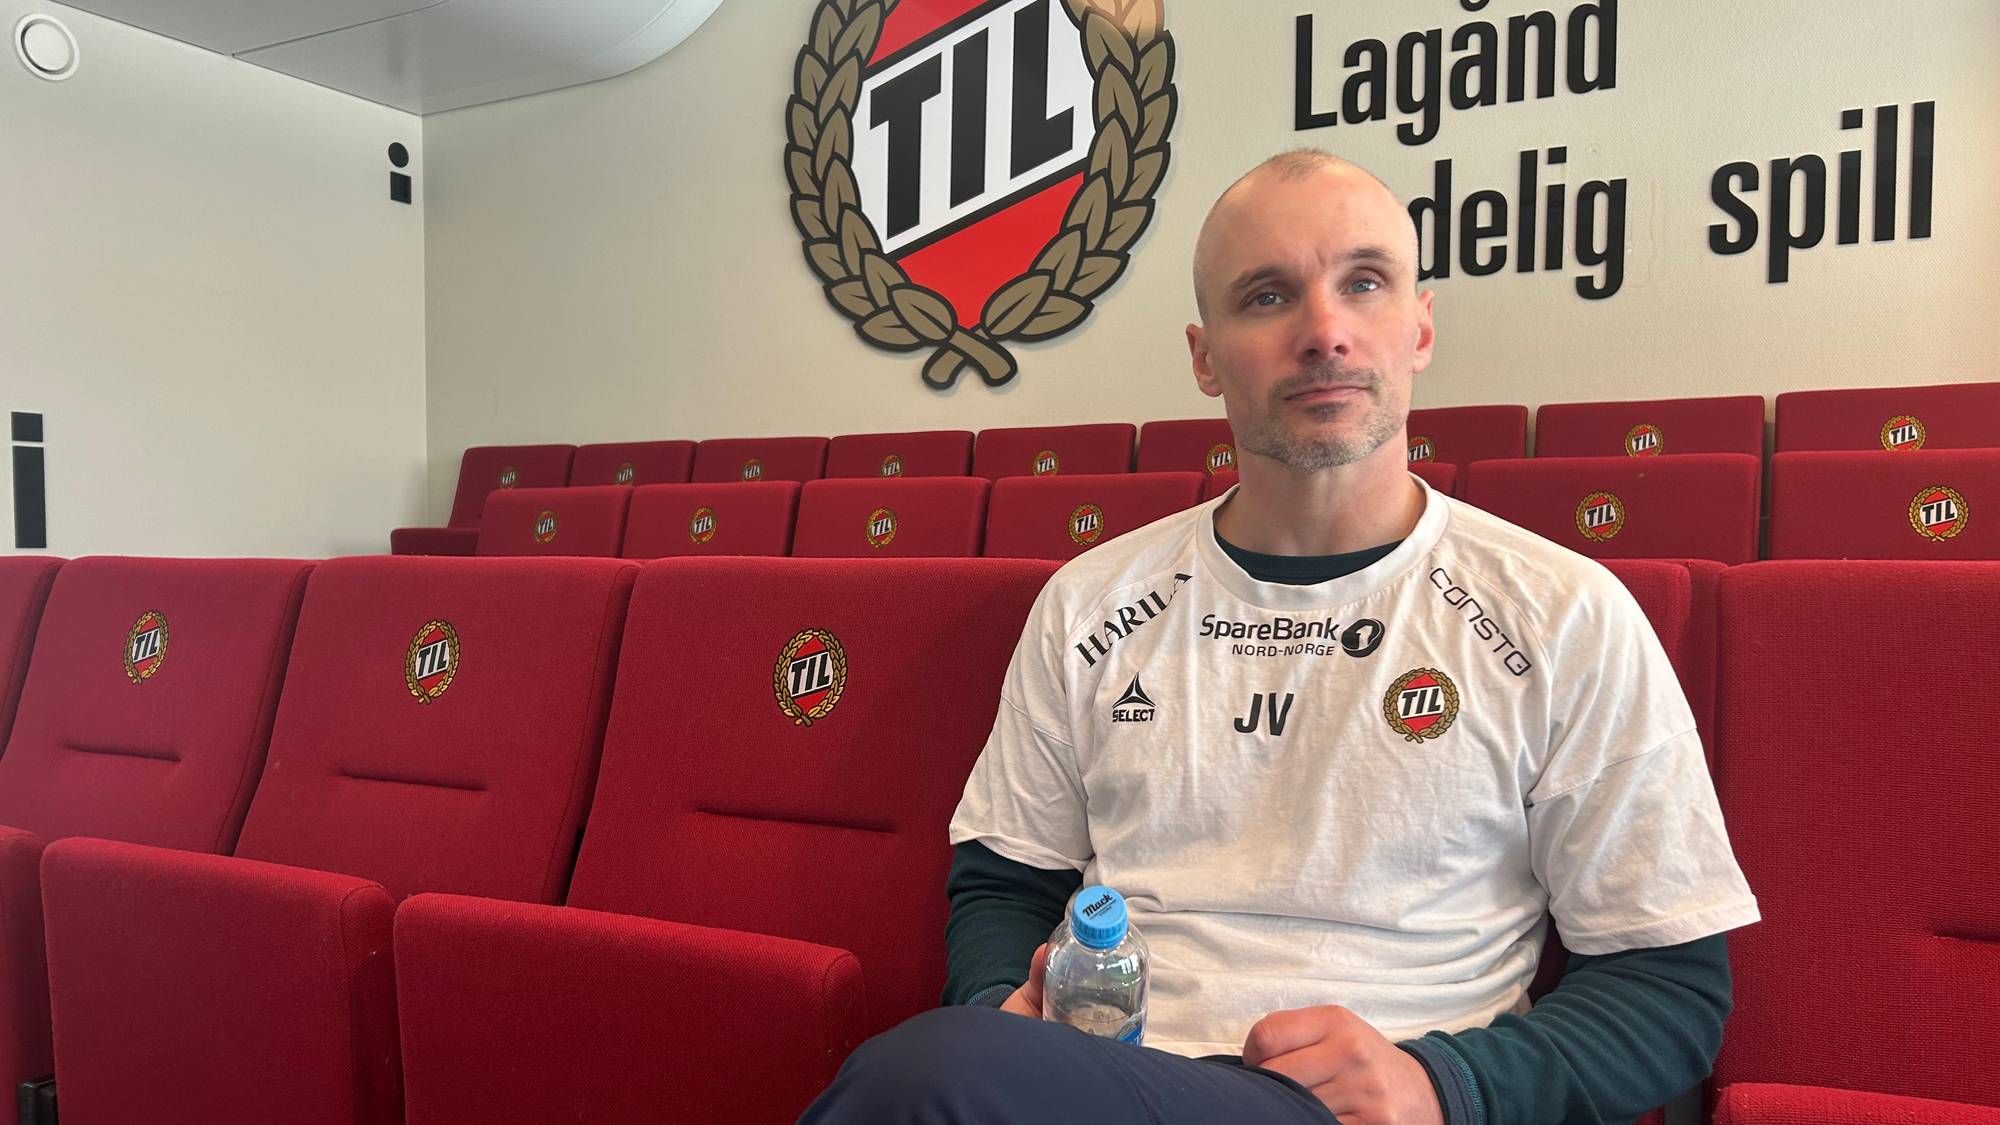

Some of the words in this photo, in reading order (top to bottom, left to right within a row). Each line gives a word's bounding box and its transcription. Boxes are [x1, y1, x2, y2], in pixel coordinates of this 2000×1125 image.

[1294, 0, 1619, 146] Lagånd
[869, 0, 1075, 241] TIL
[1410, 146, 1628, 301] delig
[1708, 100, 1936, 285] spill
[1634, 432, 1655, 450] TIL
[1890, 425, 1916, 444] TIL
[1077, 514, 1096, 532] TIL
[1586, 505, 1614, 526] TIL
[1921, 500, 1955, 525] TIL
[873, 518, 890, 535] TIL
[1199, 614, 1341, 641] SpareBank
[134, 629, 159, 661] TIL
[1232, 643, 1335, 657] NORD-NORGE
[418, 641, 447, 677] TIL
[791, 653, 830, 696] TIL
[1112, 708, 1155, 723] SELECT
[1234, 692, 1295, 736] JV
[1401, 688, 1441, 717] TIL
[1082, 893, 1113, 917] Mack
